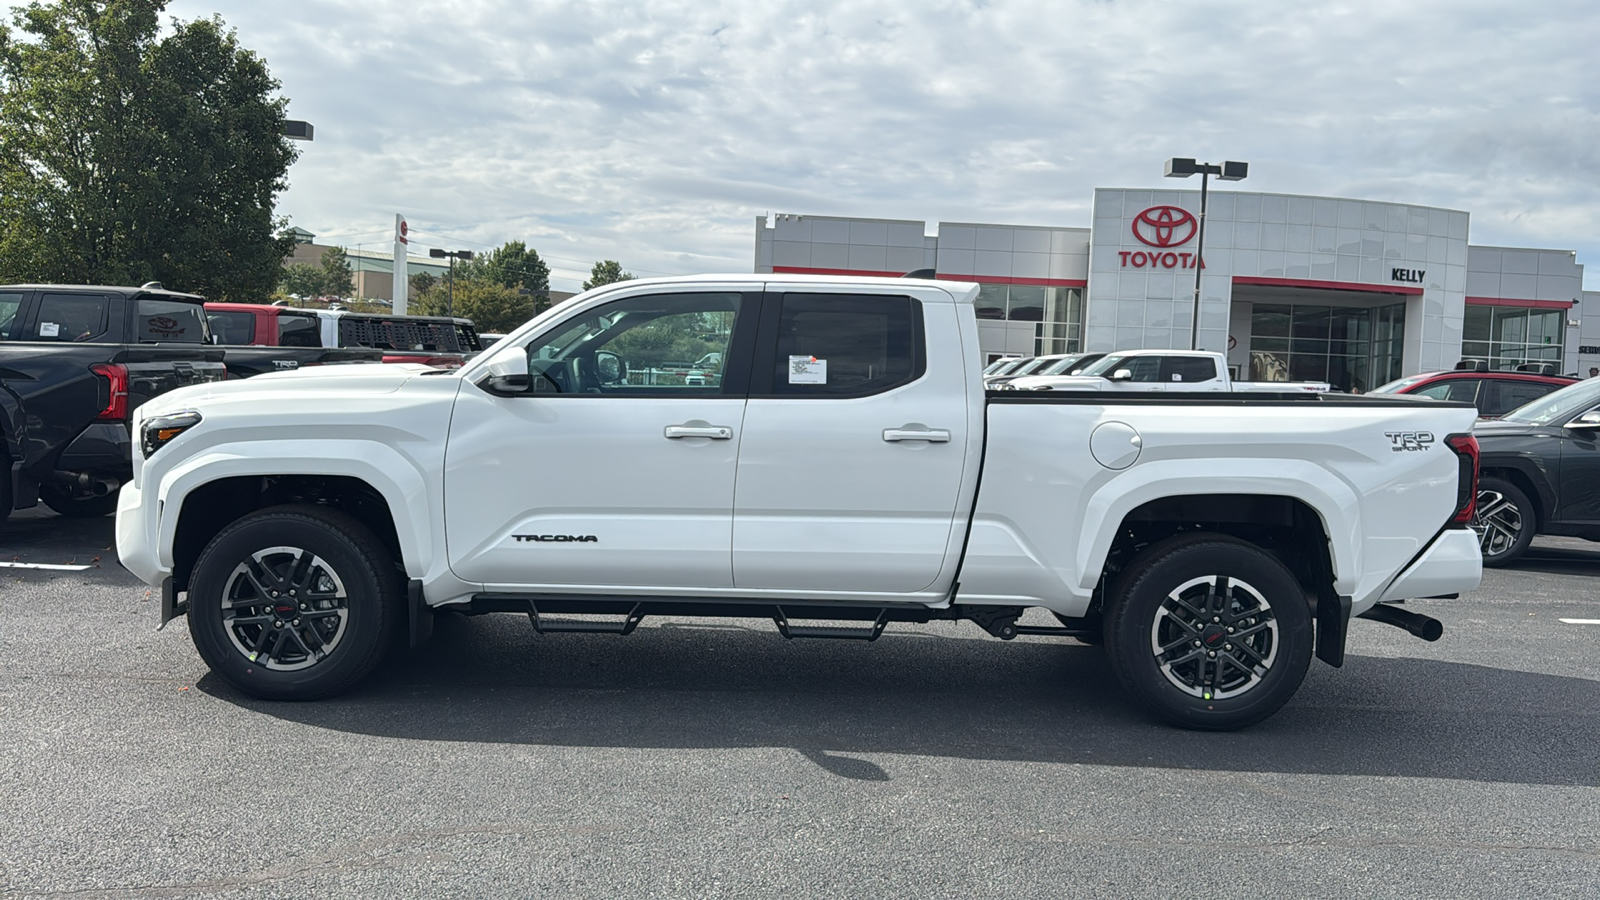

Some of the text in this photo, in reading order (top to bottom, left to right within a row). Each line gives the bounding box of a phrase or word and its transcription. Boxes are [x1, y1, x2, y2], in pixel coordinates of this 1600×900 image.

[1118, 251, 1206, 269] TOYOTA
[1391, 267, 1426, 283] KELLY
[271, 360, 299, 368] TRD
[1384, 431, 1435, 447] TRD
[511, 534, 599, 543] TACOMA
